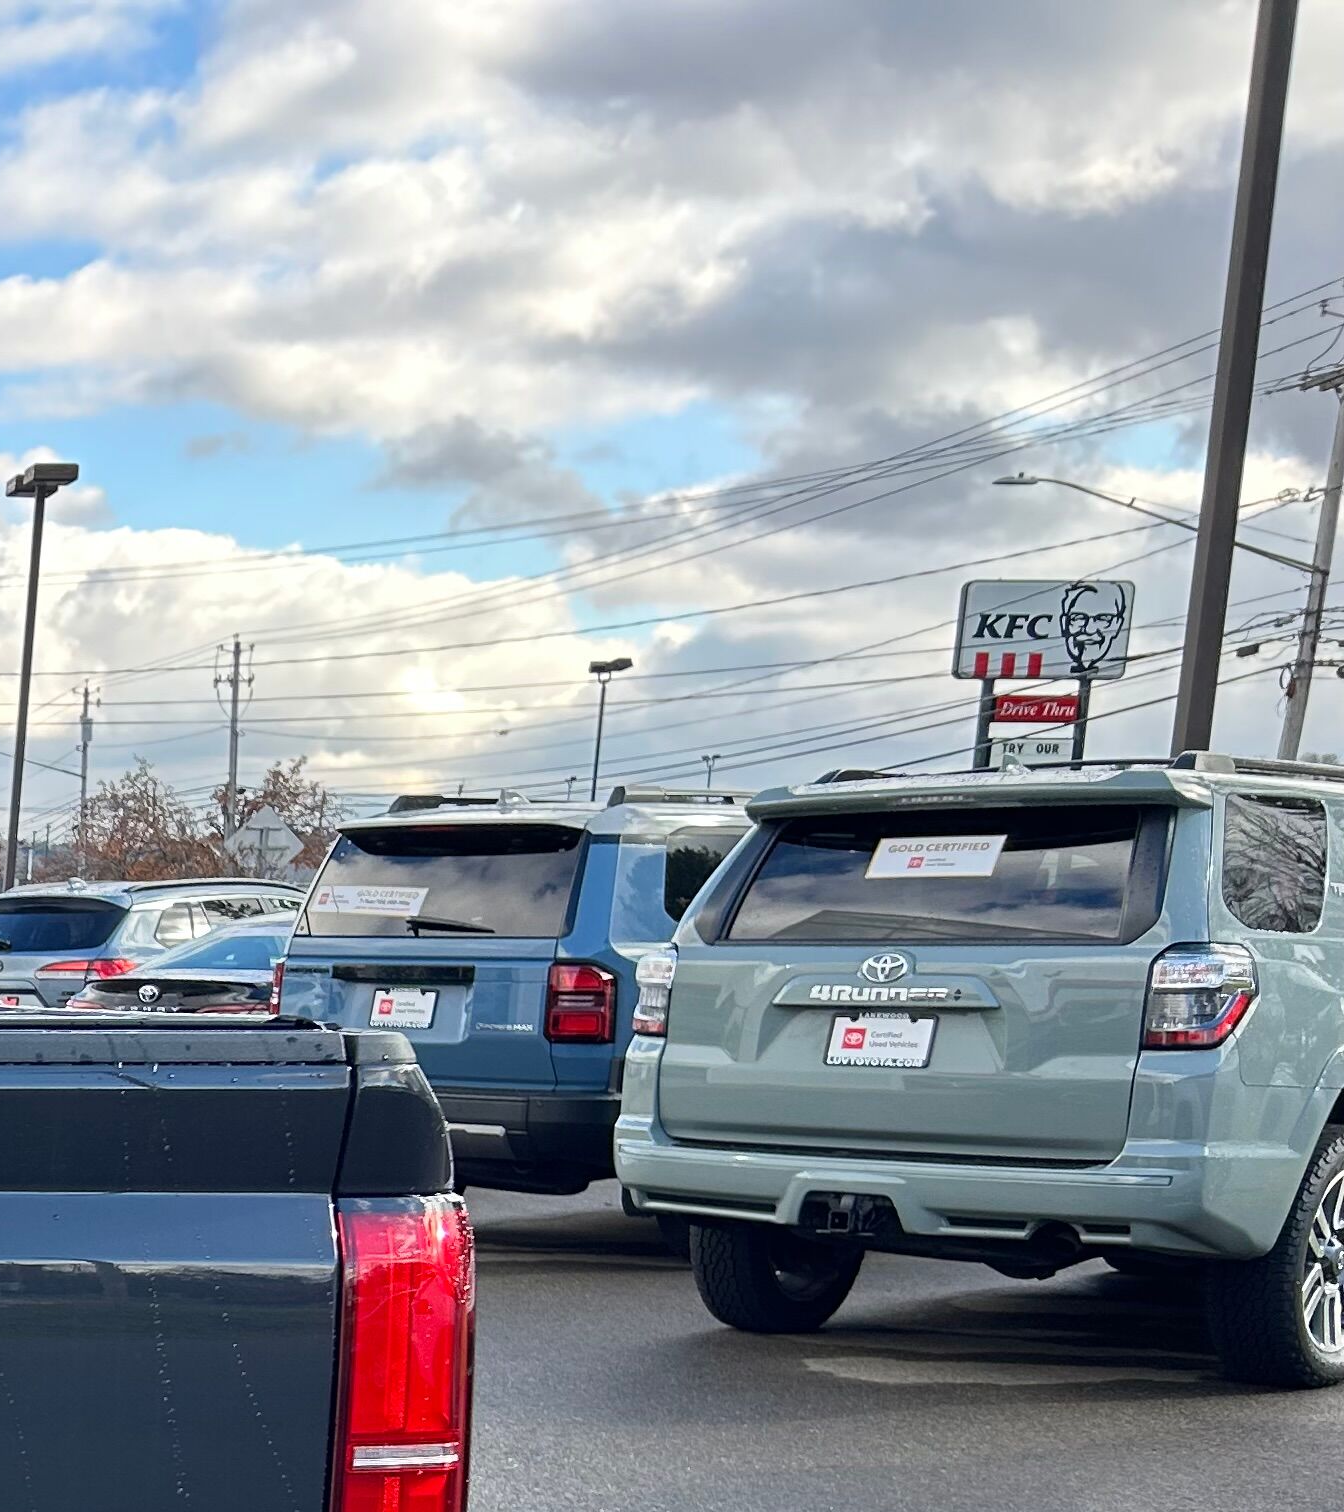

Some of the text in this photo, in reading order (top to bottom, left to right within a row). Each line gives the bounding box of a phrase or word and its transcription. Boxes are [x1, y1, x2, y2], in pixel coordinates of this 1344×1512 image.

[972, 613, 1053, 639] KFC
[999, 701, 1075, 718] Drive Thru
[1002, 743, 1059, 754] TRY OUR
[888, 841, 991, 853] GOLD CERTIFIED
